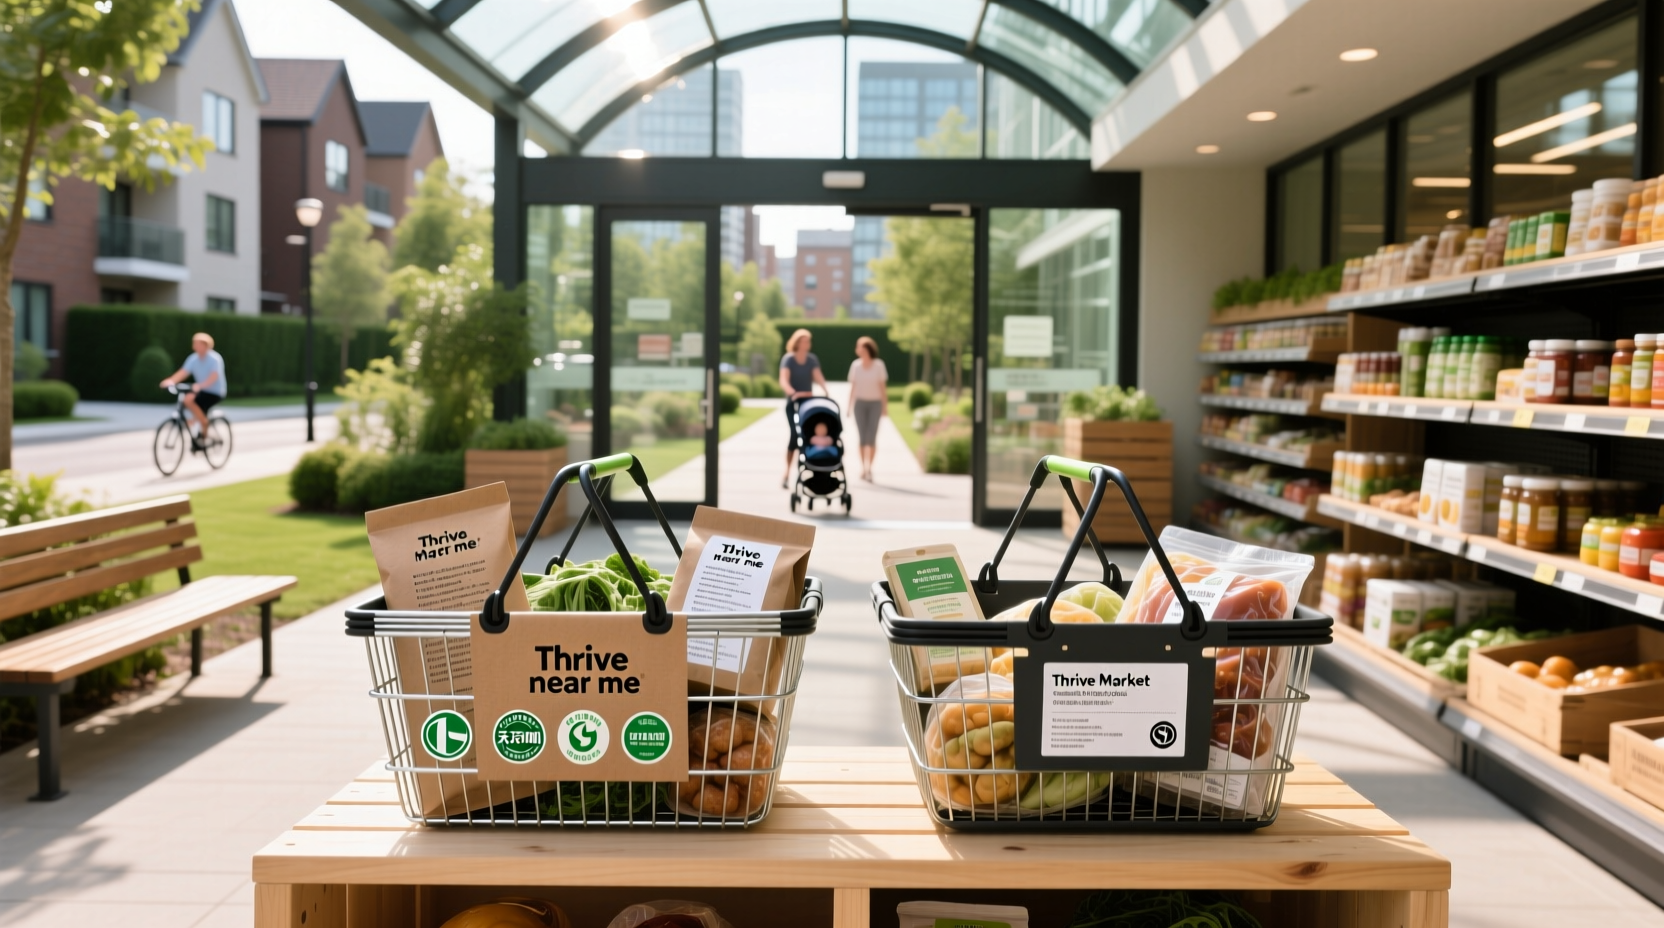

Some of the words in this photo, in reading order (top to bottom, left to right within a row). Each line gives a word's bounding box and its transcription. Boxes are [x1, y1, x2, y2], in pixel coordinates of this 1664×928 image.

[535, 644, 629, 671] Thrive
[530, 676, 591, 694] near
[599, 676, 640, 694] me
[1052, 673, 1096, 687] Thrive
[1100, 673, 1150, 687] Market
